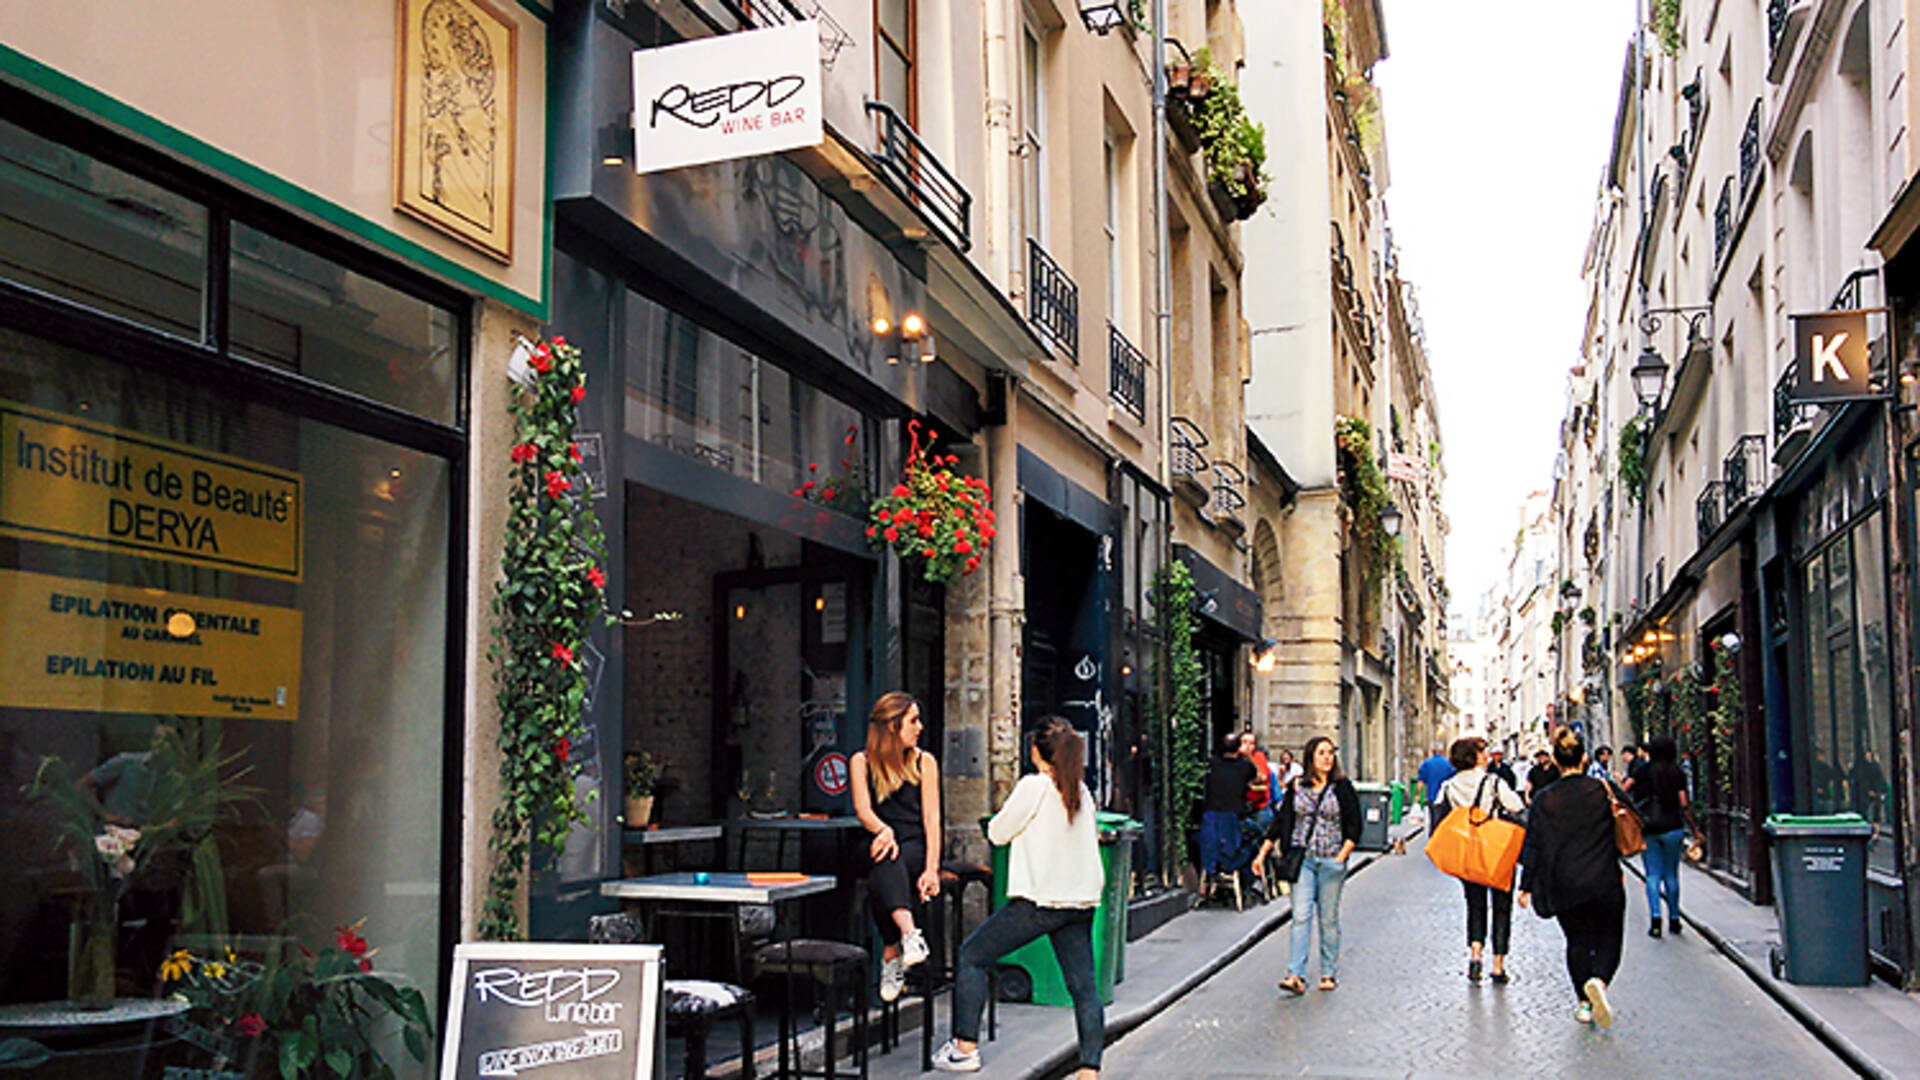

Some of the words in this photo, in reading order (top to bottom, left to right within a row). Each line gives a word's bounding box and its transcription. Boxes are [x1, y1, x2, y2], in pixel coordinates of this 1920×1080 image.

[649, 74, 806, 129] REDD
[720, 115, 764, 135] WINE
[770, 107, 805, 127] BAR
[1811, 332, 1850, 383] K
[16, 429, 132, 491] Institut
[145, 462, 183, 500] de
[192, 470, 288, 523] Beauté
[108, 498, 219, 552] DERYA
[50, 592, 156, 623] EPILATION
[164, 607, 260, 636] OENTALE
[121, 626, 139, 639] AU
[46, 655, 154, 682] EPILATION
[158, 664, 185, 685] AU
[191, 667, 218, 686] FIL
[474, 966, 621, 1007] REDD
